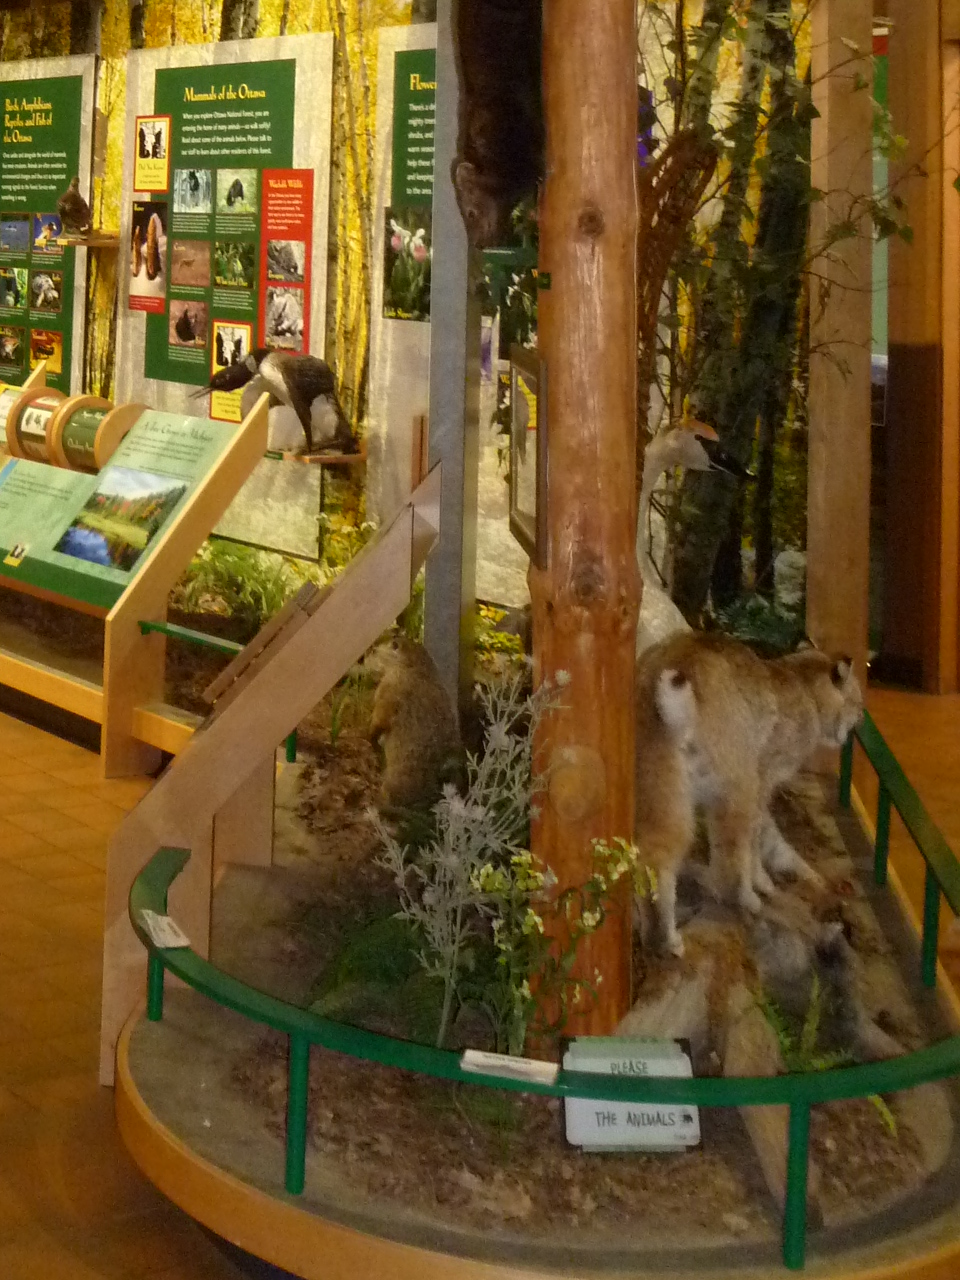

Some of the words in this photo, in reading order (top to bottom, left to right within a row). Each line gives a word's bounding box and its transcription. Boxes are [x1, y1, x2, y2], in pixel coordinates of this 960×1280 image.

[183, 85, 217, 102] Mammals
[218, 85, 226, 100] of
[226, 84, 237, 100] the
[238, 83, 266, 99] Ottawa
[610, 1061, 648, 1074] PLEASE
[595, 1111, 617, 1127] THE
[626, 1111, 676, 1128] ANIMALS
